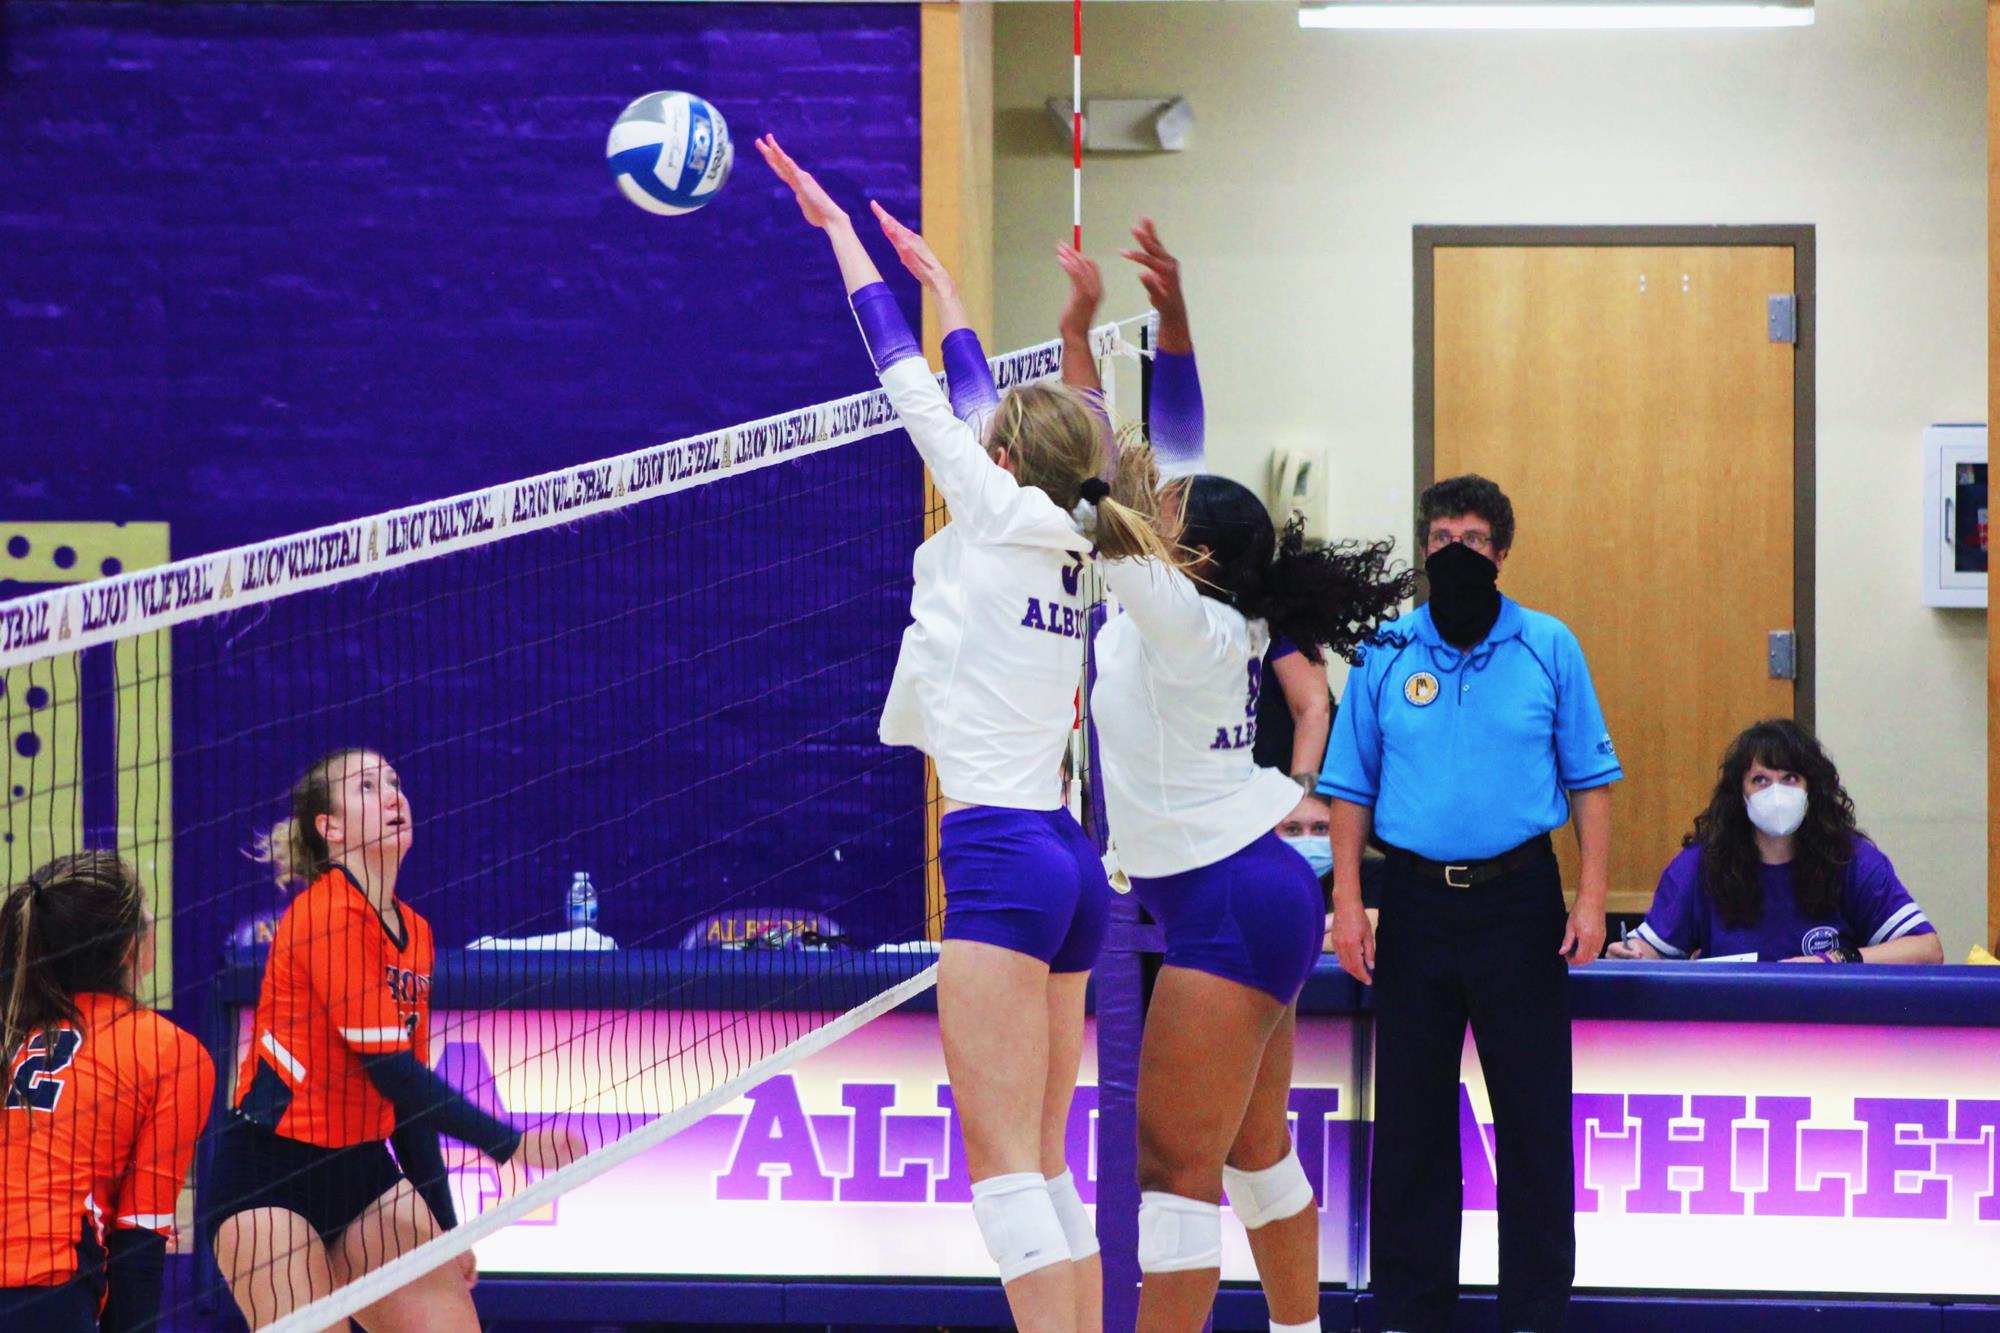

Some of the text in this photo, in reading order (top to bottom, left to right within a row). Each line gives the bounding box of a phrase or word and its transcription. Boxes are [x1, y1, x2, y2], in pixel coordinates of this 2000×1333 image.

[1021, 597, 1084, 639] ALBI
[707, 918, 819, 942] ALBON
[4, 1027, 83, 1113] 2
